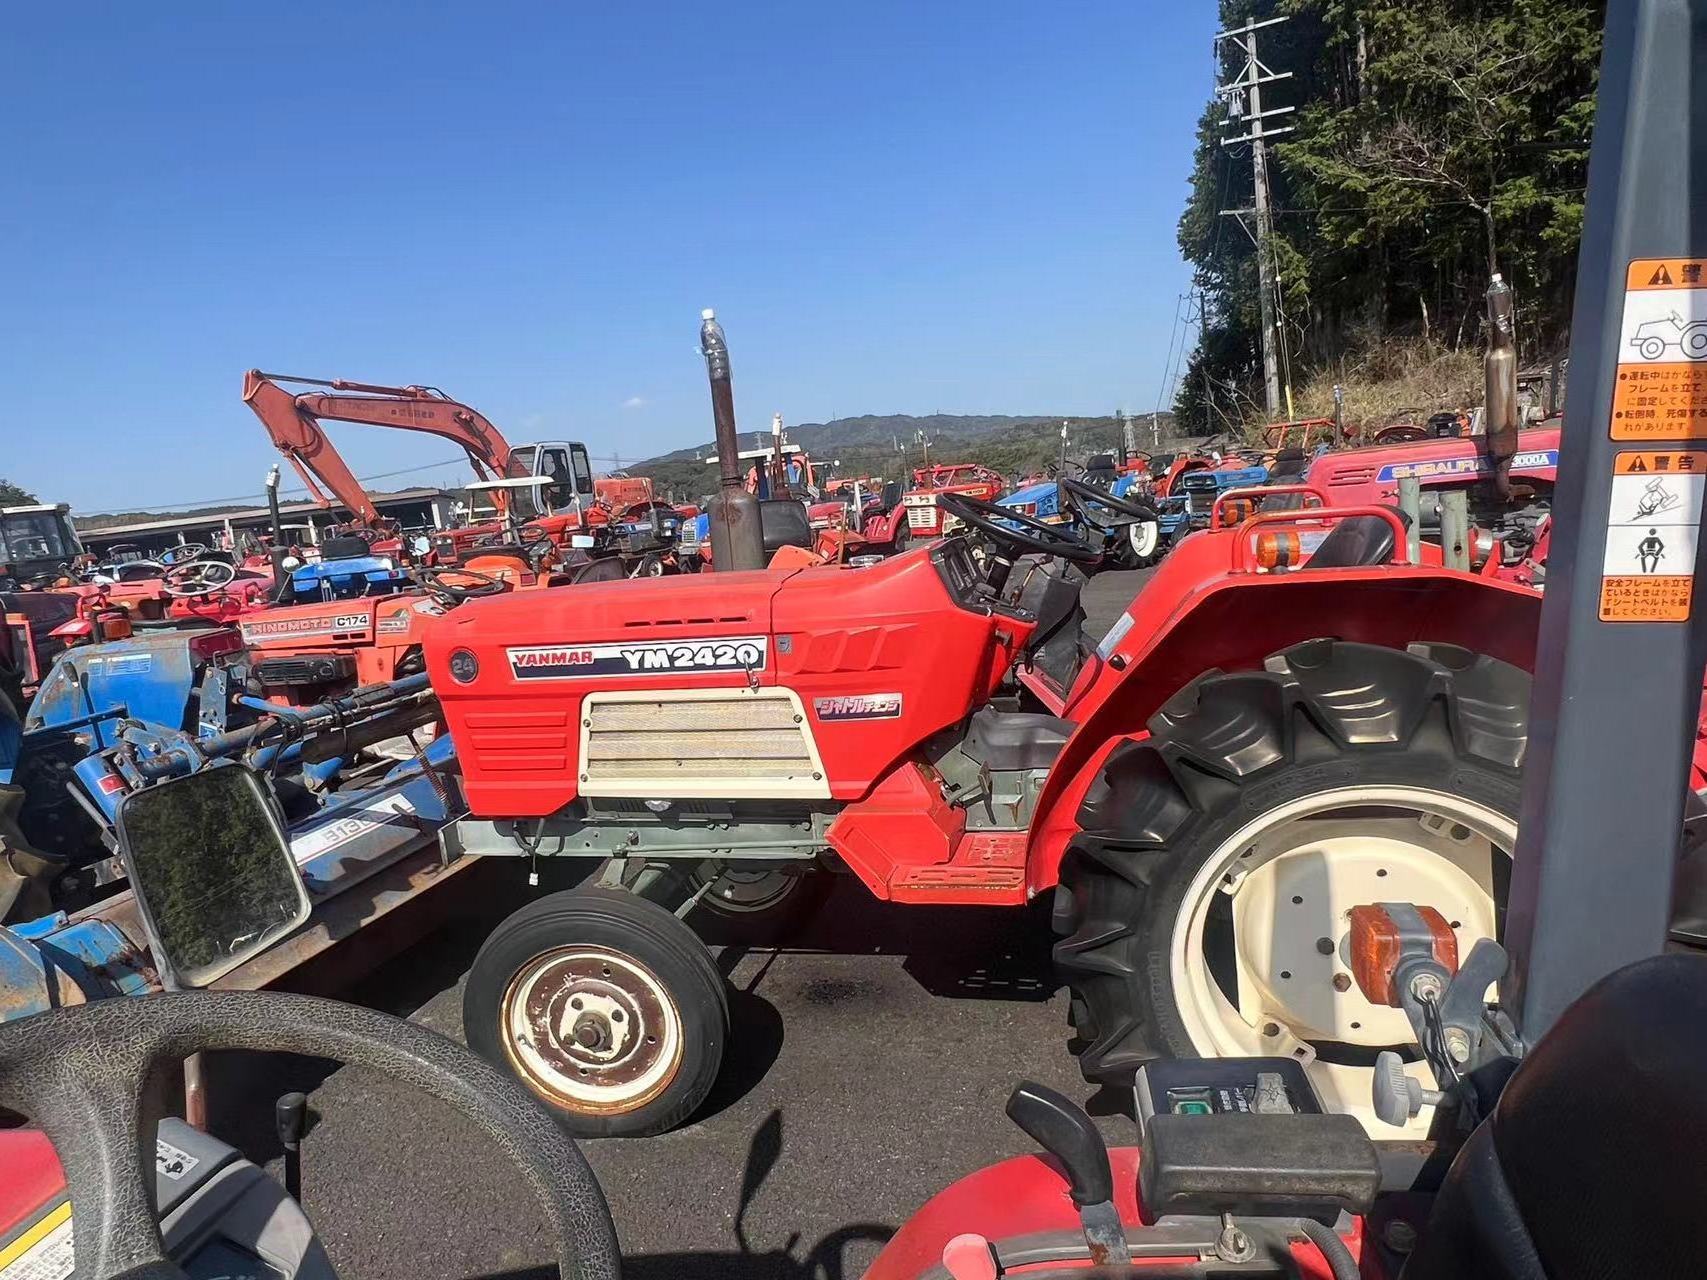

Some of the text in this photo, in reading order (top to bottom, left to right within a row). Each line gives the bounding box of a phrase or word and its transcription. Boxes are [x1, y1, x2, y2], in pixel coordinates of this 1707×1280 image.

[1629, 370, 1707, 381] 運転中はかなら
[1391, 459, 1488, 478] SHIBAURA
[1654, 456, 1694, 471] 警告
[1605, 579, 1690, 587] 安全フレームを立て
[336, 615, 368, 627] C174
[514, 643, 759, 670] YANMAR YM2420
